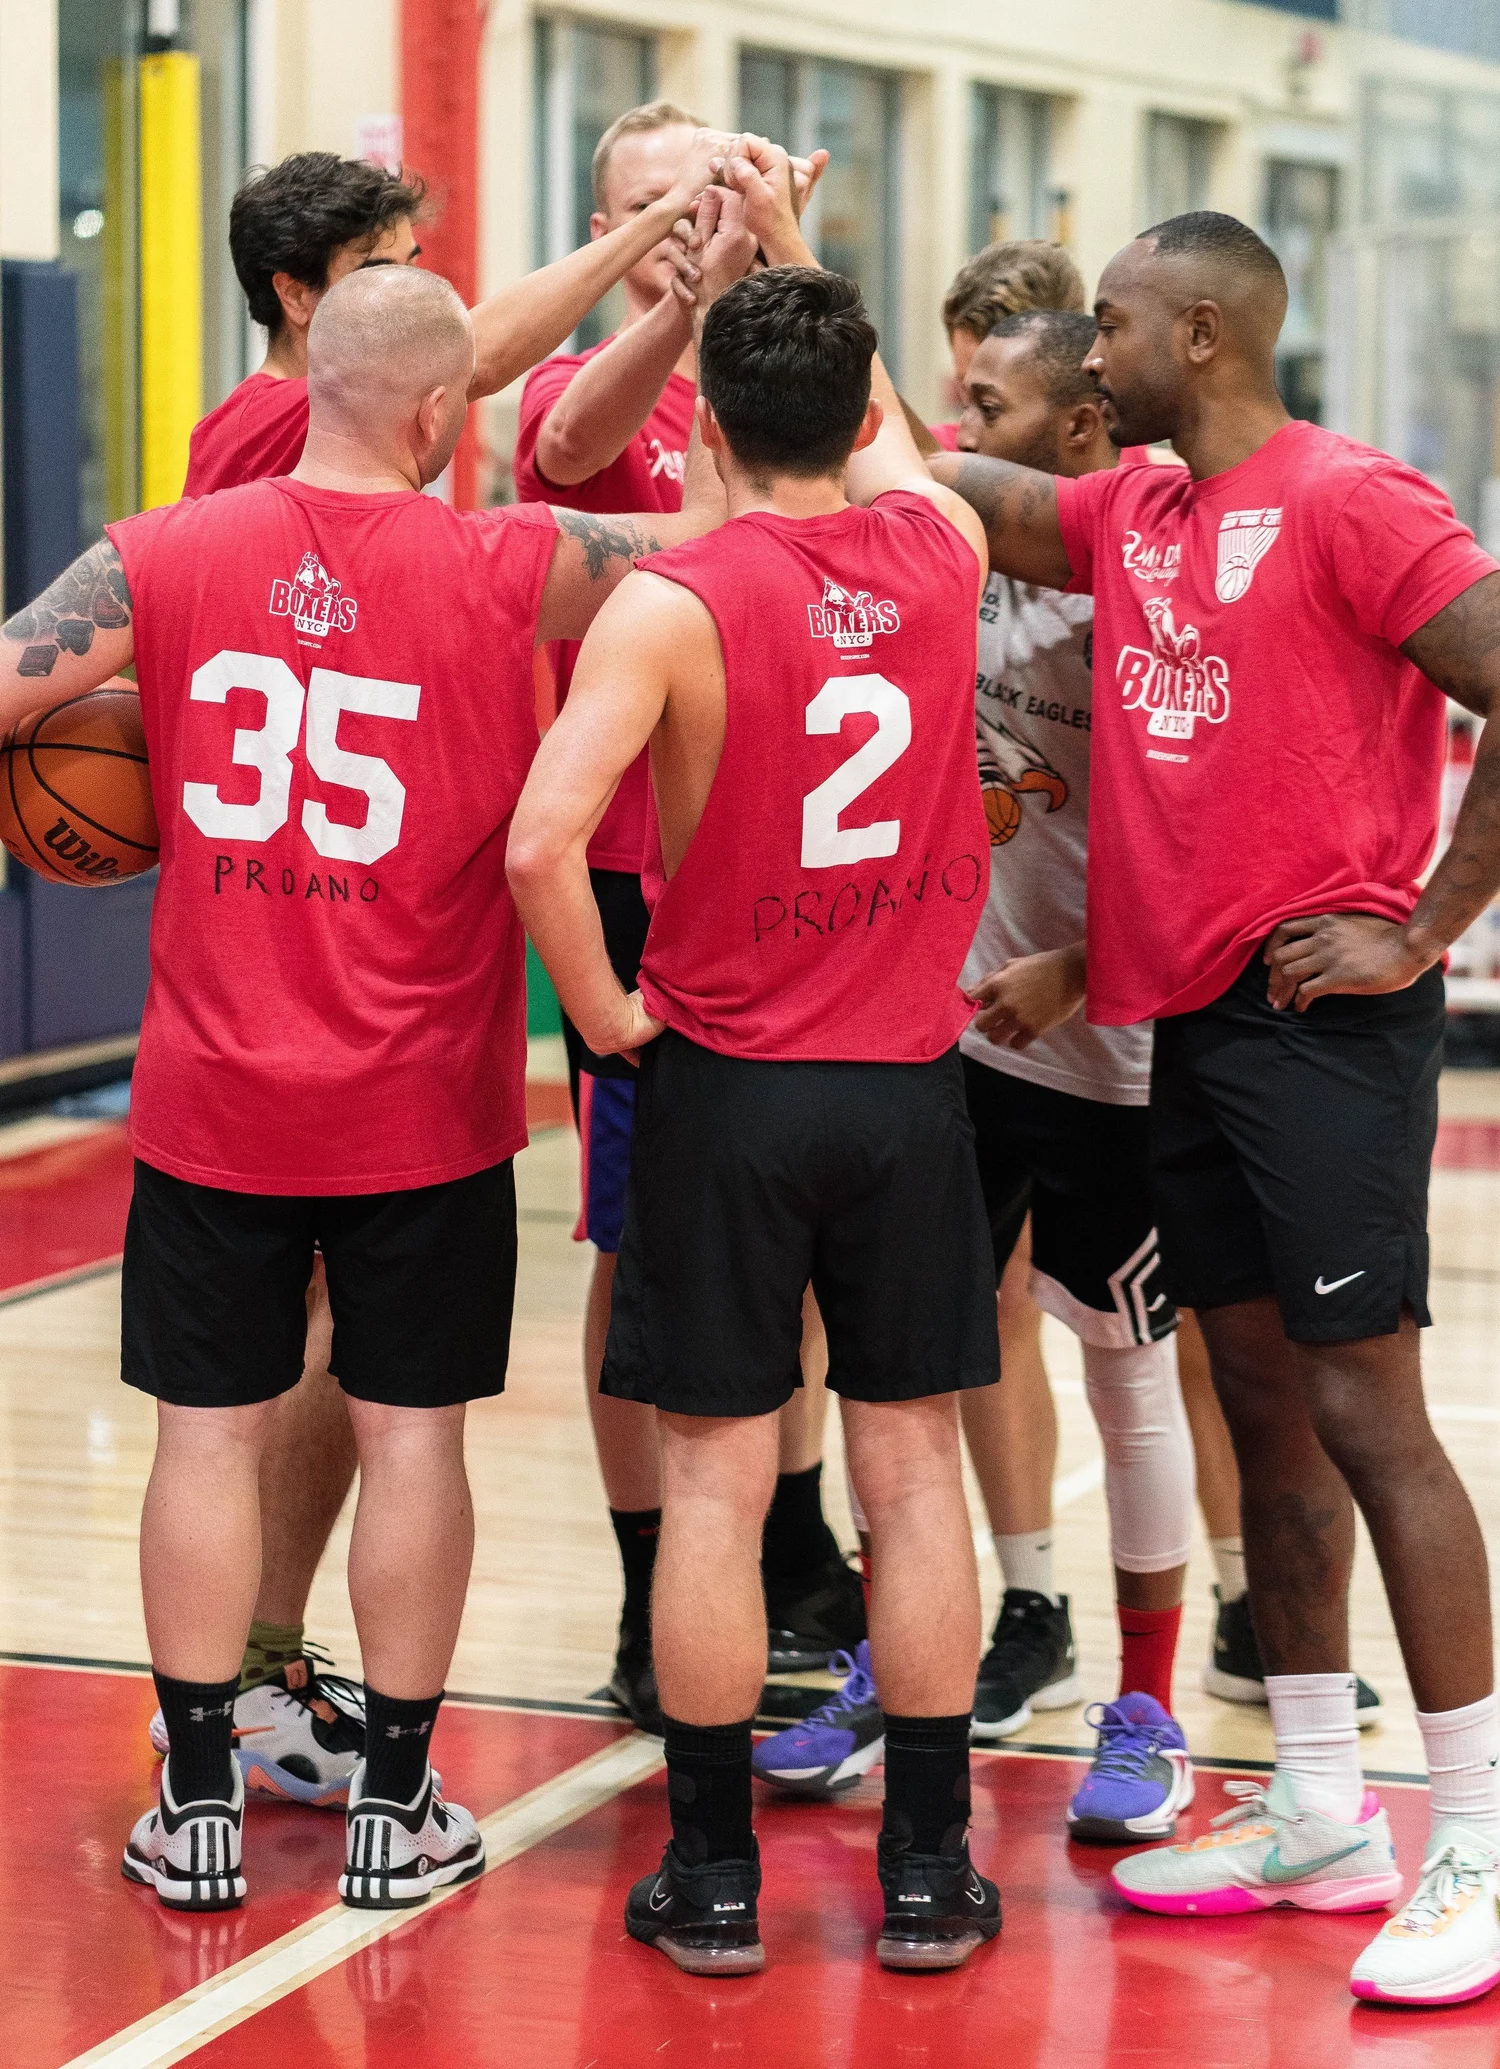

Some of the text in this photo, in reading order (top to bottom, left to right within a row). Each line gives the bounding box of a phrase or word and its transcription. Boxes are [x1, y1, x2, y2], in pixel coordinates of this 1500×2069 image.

[269, 579, 357, 633] BOXERS
[296, 618, 323, 633] NYC
[807, 599, 900, 638] BOXERS
[839, 634, 866, 645] NYC
[1115, 645, 1230, 724] BOXERS
[183, 649, 421, 865] 35
[800, 673, 912, 868] 2
[214, 855, 380, 902] PROANO
